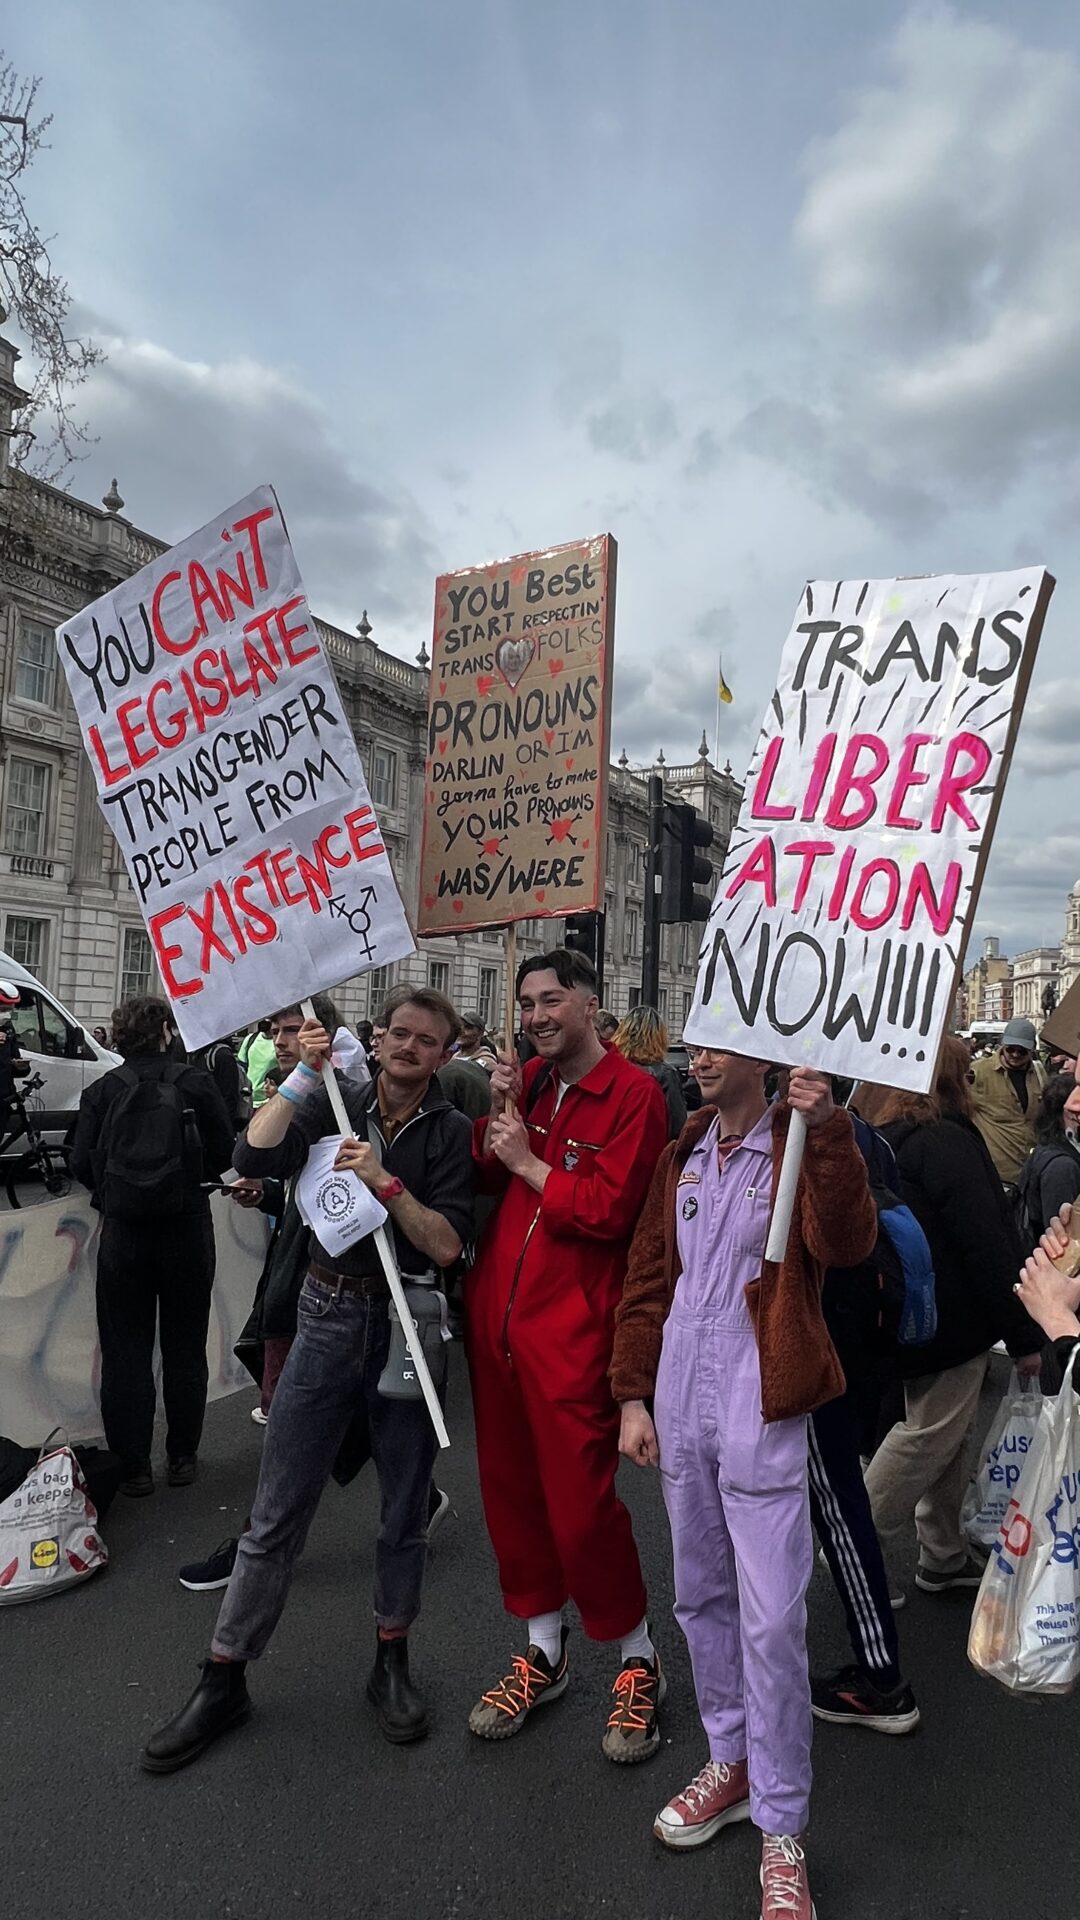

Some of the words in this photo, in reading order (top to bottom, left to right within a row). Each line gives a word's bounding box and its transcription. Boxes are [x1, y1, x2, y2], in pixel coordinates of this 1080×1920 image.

[64, 602, 154, 713] YOU
[152, 507, 274, 656] CAN'T
[448, 580, 509, 624] YOU
[438, 651, 494, 679] TRANS
[537, 620, 604, 660] FOLKS
[444, 611, 515, 654] START
[791, 610, 1025, 690] TRANS
[88, 594, 320, 787] LEGISLATE
[428, 675, 598, 756] PRONOUNS
[103, 684, 338, 844] TRANSGENDER
[432, 752, 504, 783] DARLIN
[516, 739, 549, 765] OR
[555, 728, 594, 757] I'M
[751, 731, 992, 833] LIBER
[436, 787, 497, 817] gonna
[502, 775, 541, 800] have
[545, 771, 563, 790] to
[564, 768, 598, 787] make
[132, 802, 237, 902] PEOPLE
[246, 750, 351, 830] FROM
[442, 800, 519, 853] YOUR
[526, 793, 595, 820] PRONOUNS
[149, 805, 385, 998] EXISTENCE
[437, 855, 585, 901] WAS/WERE
[725, 835, 963, 938] ATION
[14, 1499, 21, 1507] a
[28, 1488, 73, 1504] keepe
[44, 1472, 68, 1485] bag
[1036, 1604, 1055, 1614] This
[1057, 1602, 1075, 1613] bag
[1036, 1620, 1068, 1630] Reuse
[1039, 1636, 1065, 1645] Then
